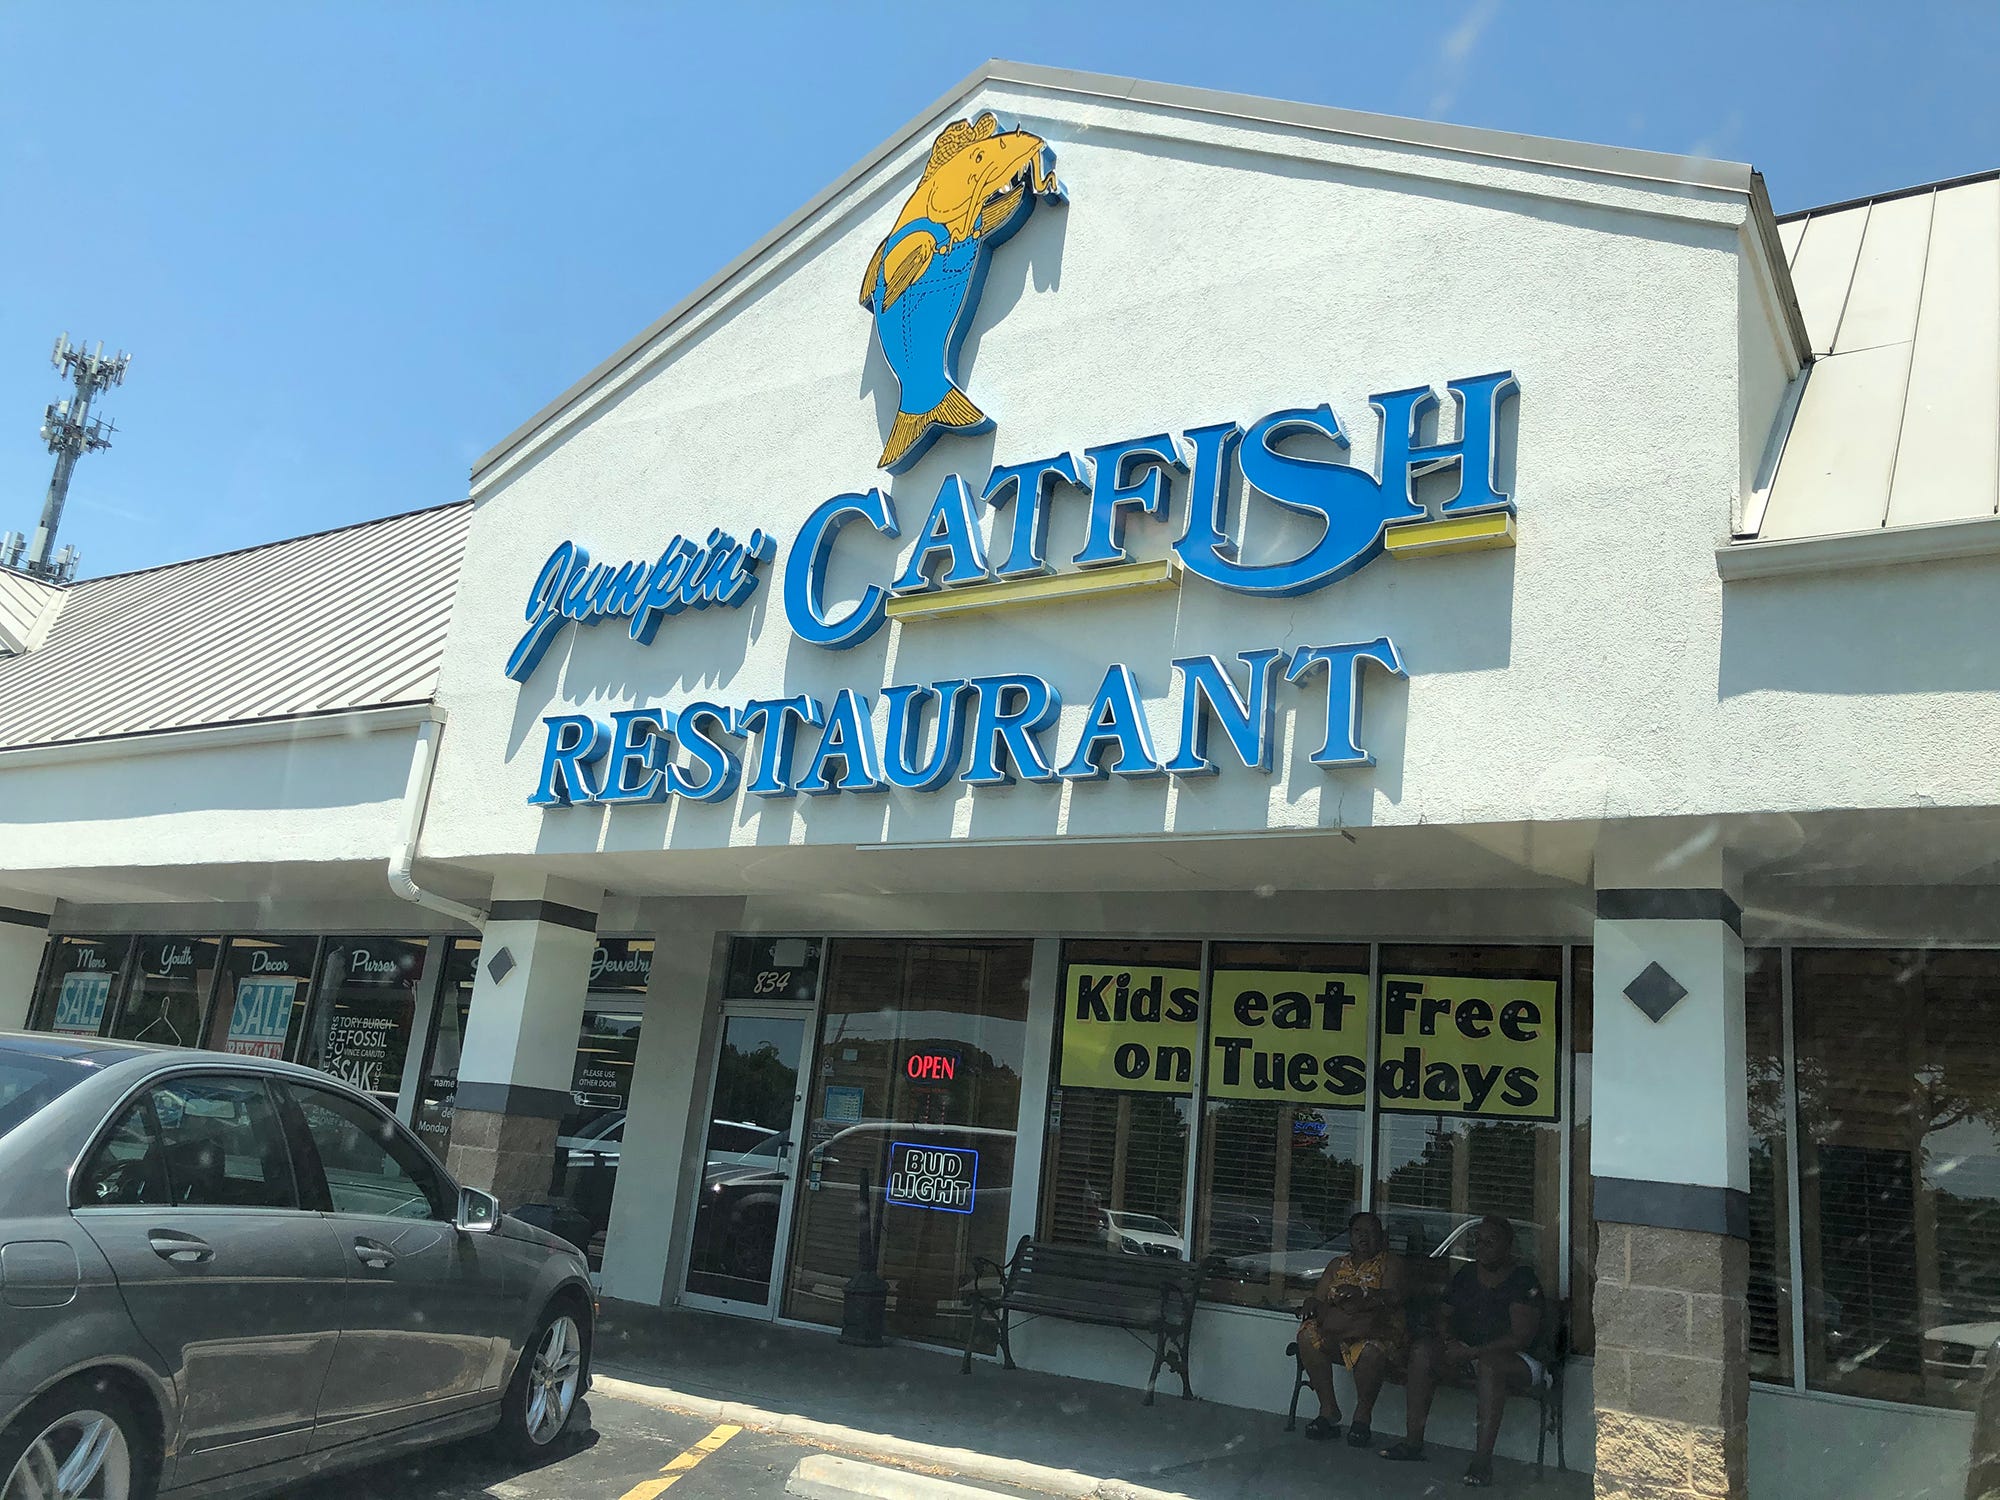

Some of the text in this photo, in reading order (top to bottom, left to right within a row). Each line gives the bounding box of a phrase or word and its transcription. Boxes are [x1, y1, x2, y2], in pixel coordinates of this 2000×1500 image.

[505, 370, 1521, 684] Jumpin' CATFISH
[527, 636, 1409, 809] RESTAURANT
[76, 948, 107, 968] Mens
[159, 944, 194, 975] Youth
[251, 950, 290, 972] Decor
[351, 949, 397, 973] Purses
[589, 947, 652, 984] Jewelry
[753, 971, 792, 994] 834
[57, 979, 108, 1024] SALE
[231, 985, 294, 1036] SALE
[1075, 973, 1542, 1042] Kids eat Free
[327, 1015, 340, 1050] KORS
[340, 1016, 393, 1030] TORY BURCH
[345, 1030, 388, 1048] FOSSIL
[360, 1049, 386, 1058] CAMUTO
[907, 1054, 955, 1080] OPEN
[340, 1059, 376, 1091] SAK
[433, 1079, 456, 1088] name
[578, 1078, 617, 1088] OTHER DOOR
[582, 1068, 616, 1079] PLEASE USE
[1113, 1036, 1540, 1111] on Tuesdays
[418, 1120, 449, 1136] Monday
[905, 1149, 962, 1178] BUD
[891, 1172, 971, 1206] LIGHT
